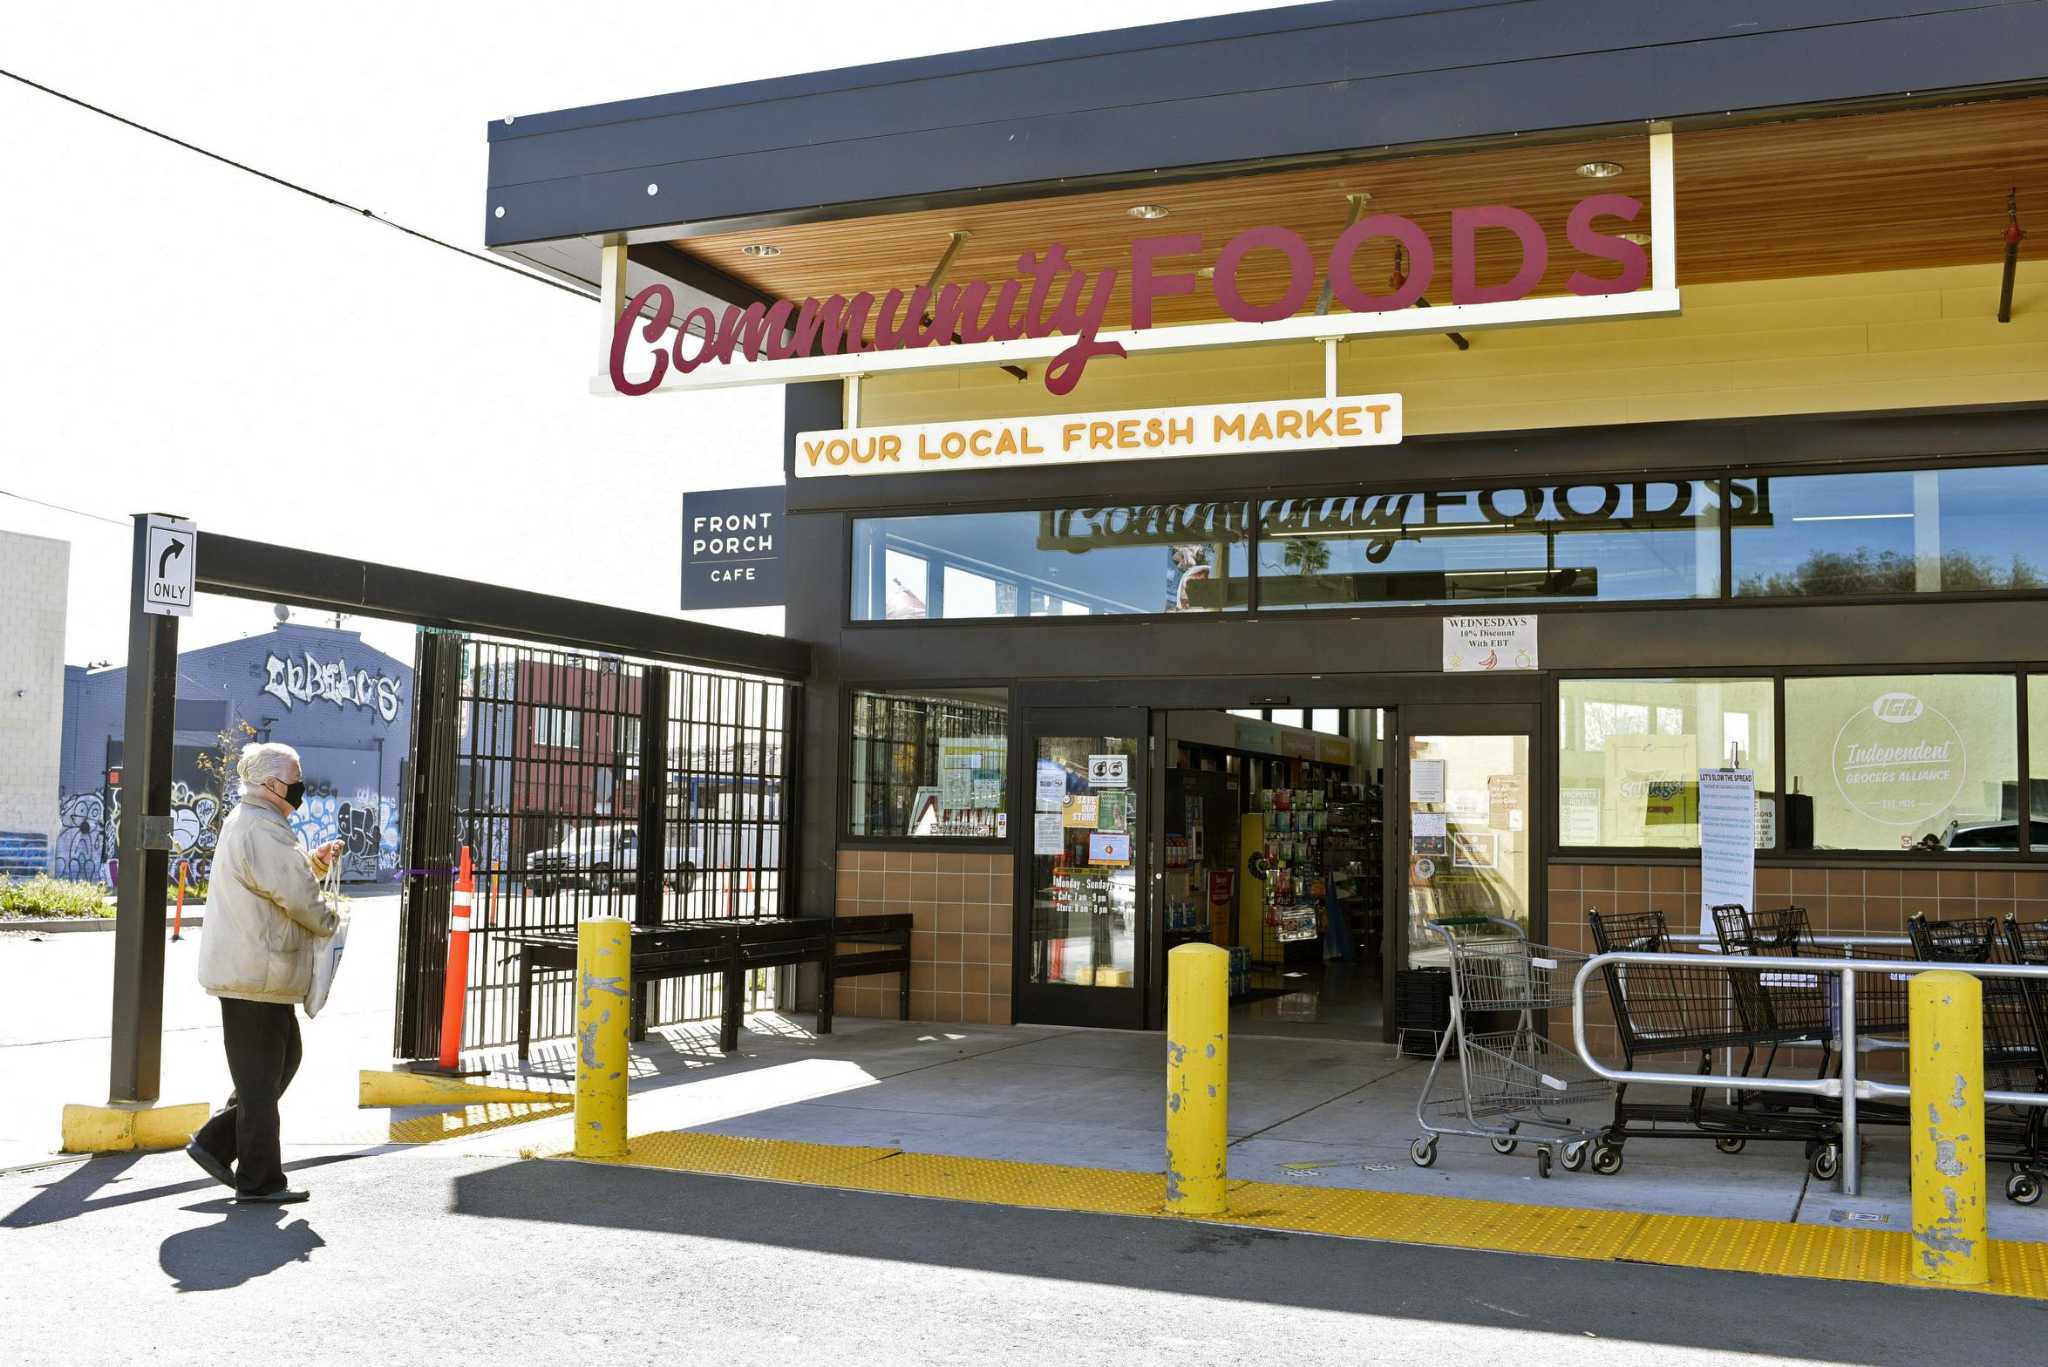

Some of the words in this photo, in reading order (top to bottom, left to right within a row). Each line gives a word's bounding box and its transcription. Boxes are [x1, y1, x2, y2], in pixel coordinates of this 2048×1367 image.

[609, 243, 1128, 396] Community
[1131, 193, 1650, 330] FOODS
[803, 435, 902, 466] YOUR
[918, 427, 1043, 460] LOCAL
[1062, 417, 1195, 453] FRESH
[1213, 404, 1392, 443] MARKET
[694, 513, 772, 533] FRONT
[693, 535, 772, 555] PORCH
[711, 568, 756, 582] CAFE
[154, 582, 185, 599] ONLY
[1449, 617, 1528, 628] WEDNESDAYS
[1480, 629, 1515, 637] Discount
[1469, 639, 1488, 647] With
[1491, 639, 1509, 647] EBT
[1846, 740, 1953, 766] Independent
[1846, 770, 1895, 784] GROCERS
[1898, 768, 1951, 782] ALLIANCE
